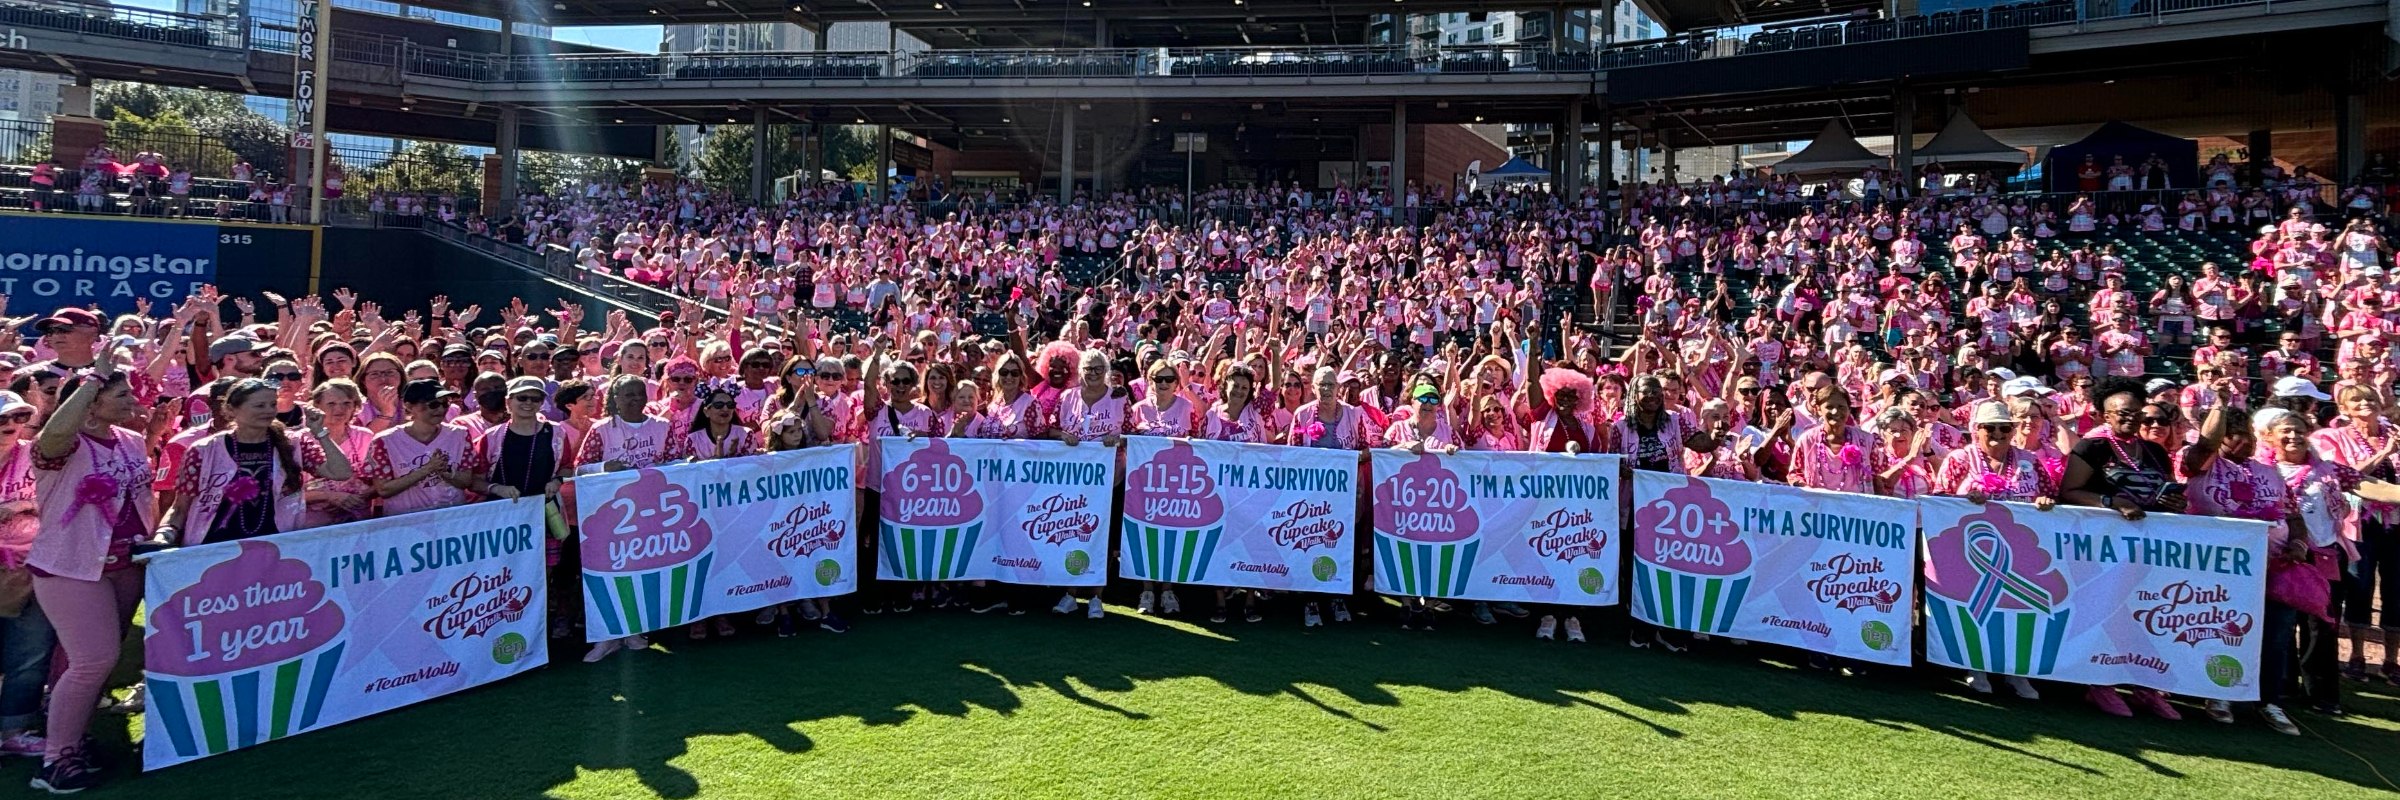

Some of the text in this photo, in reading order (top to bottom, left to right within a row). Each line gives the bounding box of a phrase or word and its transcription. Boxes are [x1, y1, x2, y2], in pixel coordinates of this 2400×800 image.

[297, 70, 314, 127] FOWL
[220, 234, 253, 245] 315
[737, 479, 752, 505] A
[756, 466, 849, 501] SURVIVOR
[901, 463, 962, 493] 6-10
[1004, 459, 1017, 483] A
[1021, 460, 1106, 486] SURVIVOR
[1143, 463, 1206, 495] 11-15
[1248, 465, 1260, 489] A
[1264, 466, 1349, 493] SURVIVOR
[1390, 477, 1456, 509] 16-20
[1503, 475, 1515, 499] A
[1520, 474, 1609, 501] SURVIVOR
[613, 489, 685, 535] 2-5
[769, 501, 832, 532] The Pink
[899, 496, 961, 523] years
[1026, 493, 1088, 517] The Pink
[1144, 496, 1202, 522] years
[1271, 499, 1333, 522] The Pink
[1531, 506, 1593, 533] The Pink
[1654, 499, 1729, 539] 20+
[1022, 512, 1099, 542] Cupcake
[1054, 530, 1076, 544] Walk
[1268, 517, 1344, 547] Cupcake
[1394, 510, 1456, 535] years
[1781, 510, 1795, 536] A
[1800, 511, 1906, 550] SURVIVOR
[383, 546, 405, 577] A
[410, 523, 533, 573] SURVIVOR
[609, 530, 692, 570] years
[767, 518, 846, 558] Cupcake
[1300, 536, 1322, 549] Walk
[1528, 526, 1608, 558] Cupcake
[1654, 537, 1724, 568] years
[992, 555, 1042, 572] #TeamMolly
[1564, 547, 1587, 561] Walk
[1810, 552, 1885, 578] The Pink
[2099, 535, 2119, 563] A
[2121, 535, 2252, 577] THRIVER
[1229, 561, 1290, 577] #TeamMolly
[1491, 574, 1556, 590] #TeamMolly
[183, 579, 307, 620] Less than
[426, 566, 513, 610] The Pink
[726, 575, 793, 597] #TeamMolly
[1806, 574, 1902, 605] Cupcake
[2136, 580, 2231, 607] The Pink
[423, 586, 532, 640] Cupcake
[1845, 596, 1872, 610] Walk
[474, 611, 504, 634] Walk
[1761, 615, 1832, 638] #TeamMolly
[2133, 604, 2253, 637] Cupcake
[2185, 628, 2217, 642] Walk
[185, 616, 310, 663] 1 year
[2090, 651, 2170, 674] #TeamMolly
[364, 661, 461, 694] #TeamMolly
